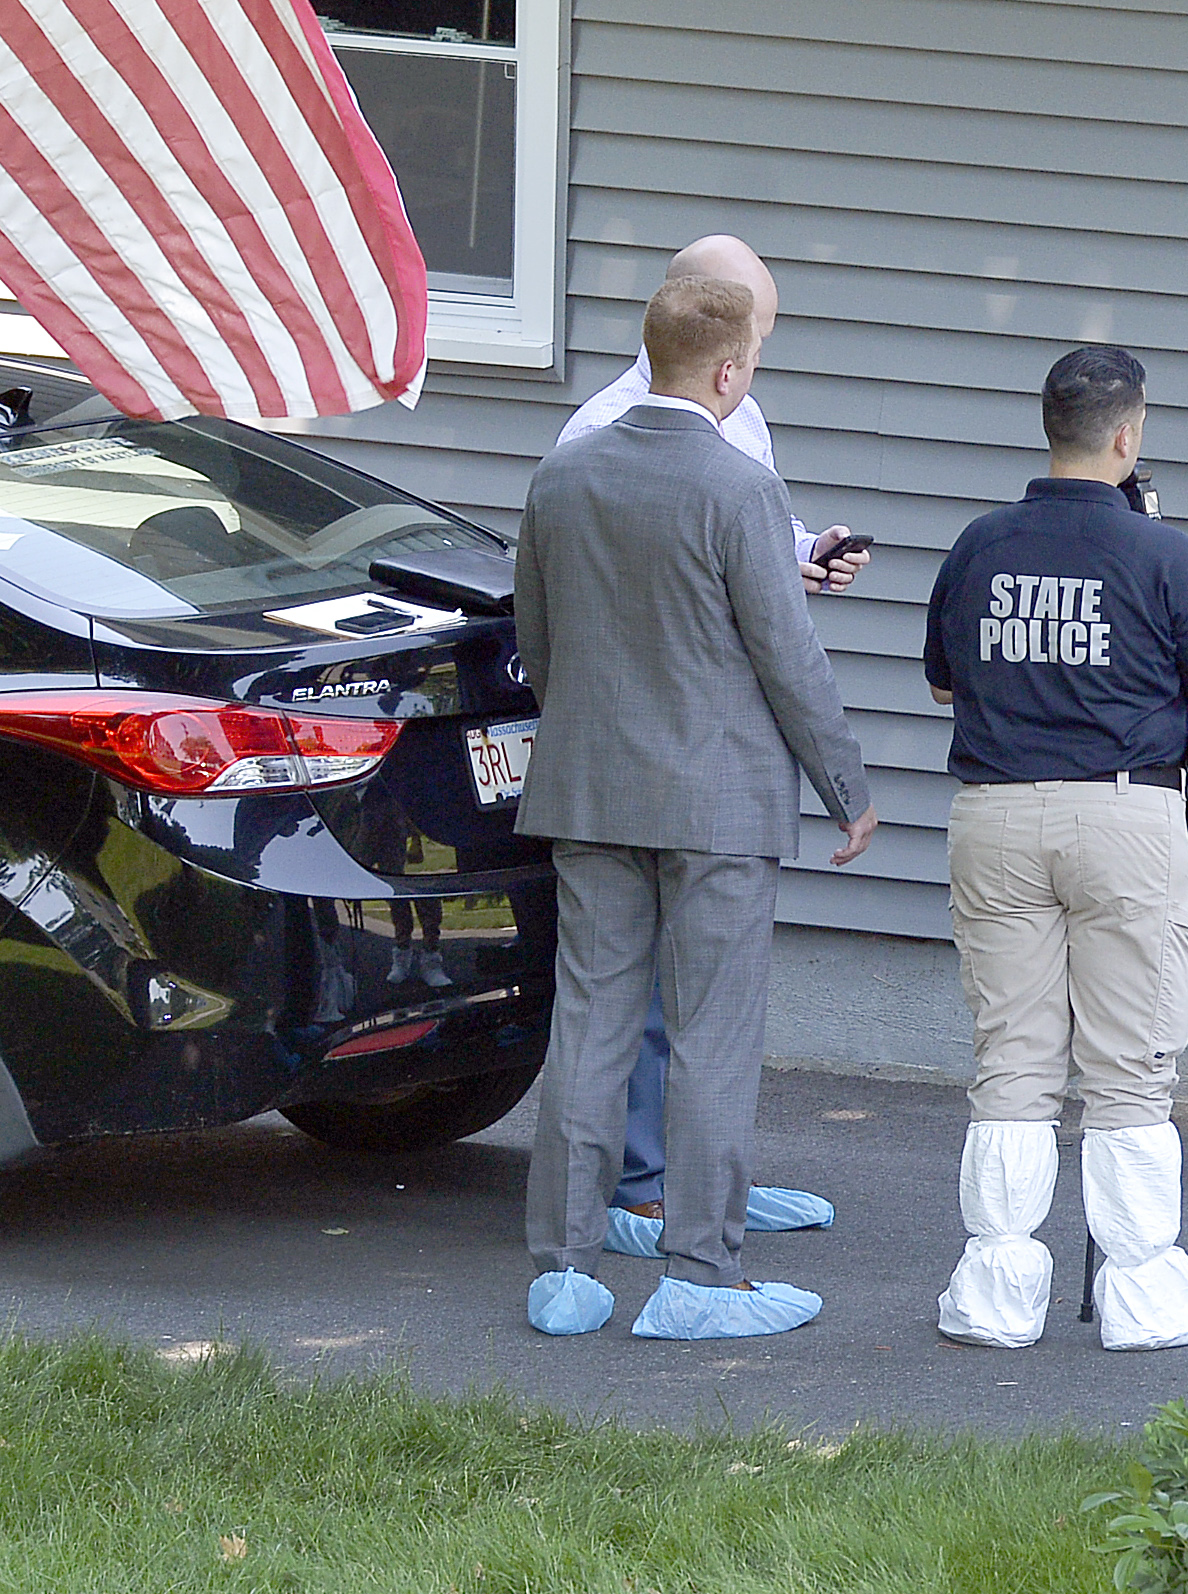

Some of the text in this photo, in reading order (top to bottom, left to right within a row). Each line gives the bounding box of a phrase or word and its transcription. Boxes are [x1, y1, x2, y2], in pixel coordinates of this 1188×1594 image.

[990, 573, 1103, 622] STATE
[980, 618, 1111, 666] POLICE
[292, 679, 391, 702] ELANTRA
[472, 742, 521, 786] 3RL
